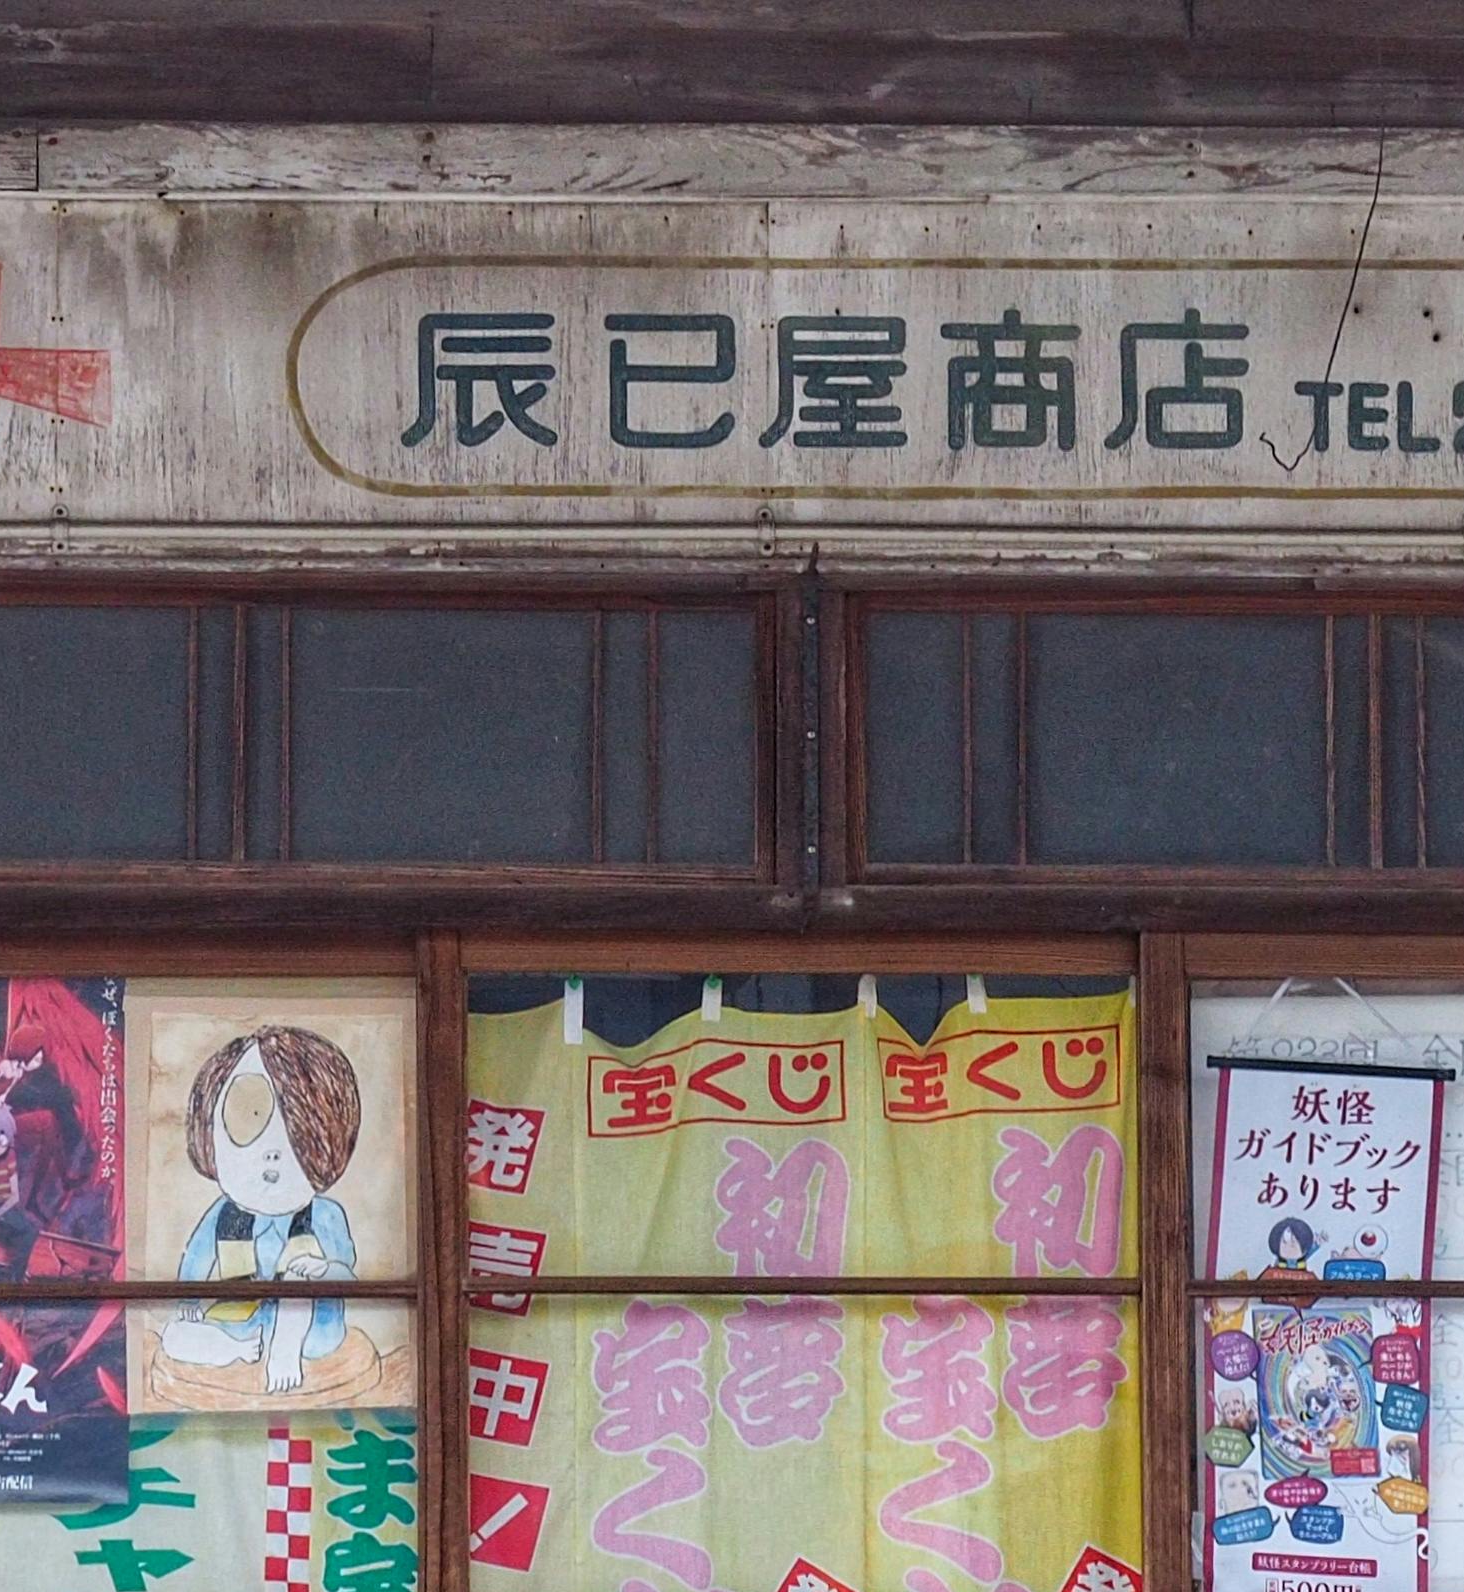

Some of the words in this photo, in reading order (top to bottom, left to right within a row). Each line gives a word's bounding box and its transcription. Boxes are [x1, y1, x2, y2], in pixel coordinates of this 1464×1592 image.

[602, 1052, 831, 1129] 宝くじ
[885, 1037, 1108, 1114] 宝くじ
[1291, 1085, 1376, 1126] 妖怪
[1233, 1128, 1422, 1170] ガイドブック
[1257, 1172, 1401, 1214] あります
